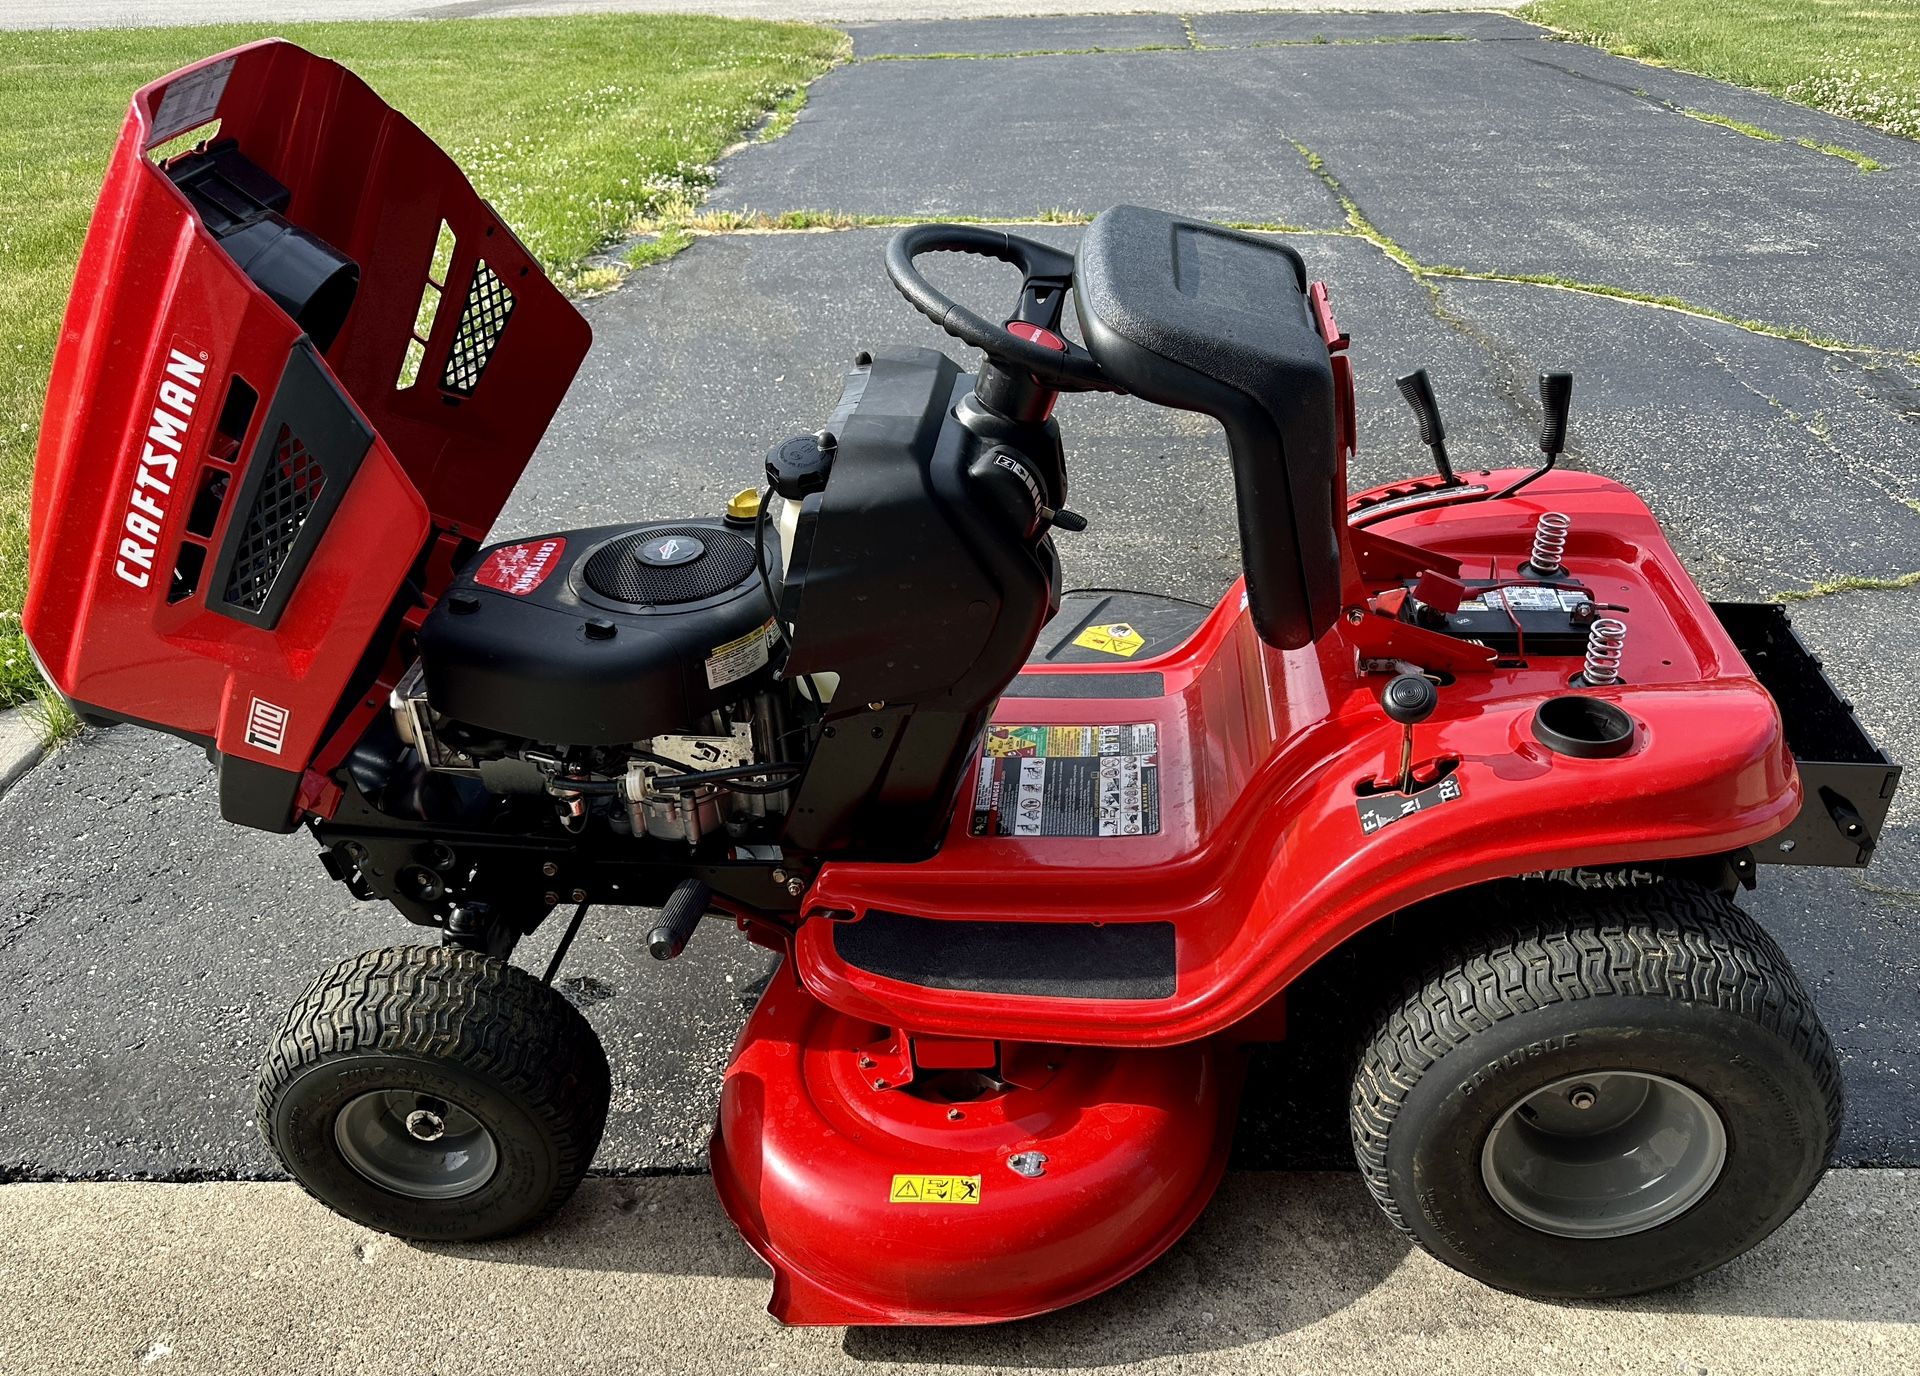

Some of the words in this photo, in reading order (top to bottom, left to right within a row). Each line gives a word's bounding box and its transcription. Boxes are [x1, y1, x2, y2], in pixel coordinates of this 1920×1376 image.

[115, 349, 207, 589] CRAFTSMAN
[510, 542, 557, 594] CRAFTSMAN
[248, 703, 284, 750] T110
[991, 781, 1001, 806] DANGER
[1457, 1032, 1578, 1097] CARLISLE
